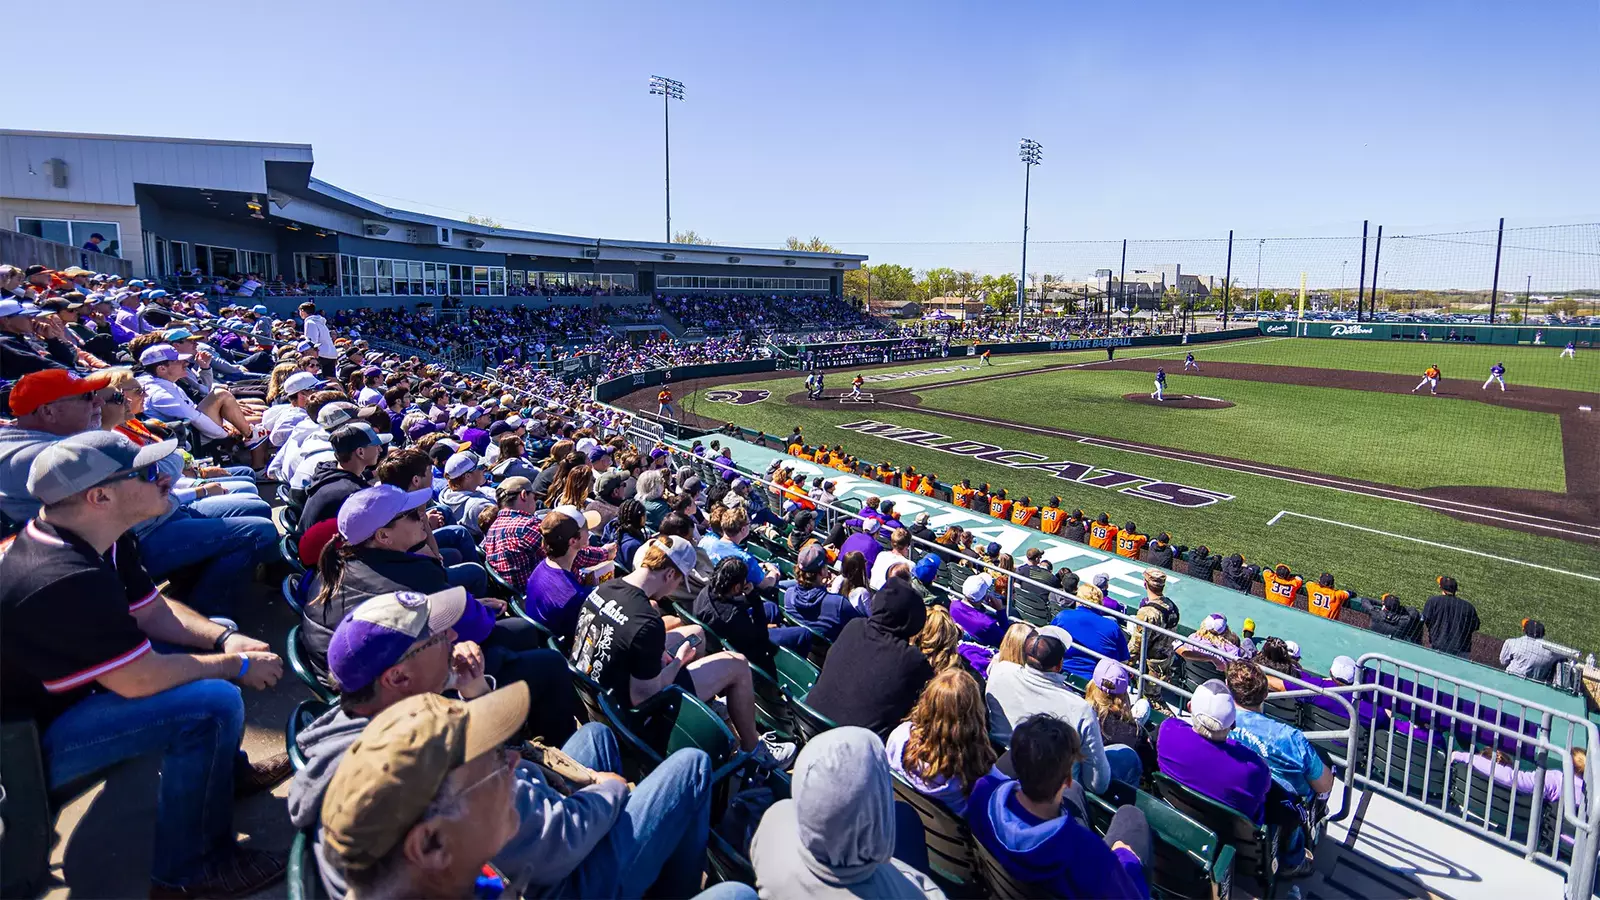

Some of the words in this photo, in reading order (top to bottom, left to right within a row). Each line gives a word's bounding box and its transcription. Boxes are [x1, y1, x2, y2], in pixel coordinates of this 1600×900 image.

[1058, 339, 1091, 350] K-STATE
[1092, 337, 1132, 348] BASEBALL
[835, 419, 1235, 507] WILDCATS
[1043, 510, 1057, 521] 24
[1092, 526, 1107, 539] 48
[1119, 538, 1134, 550] 33
[1271, 580, 1292, 597] 32
[1313, 592, 1331, 609] 31
